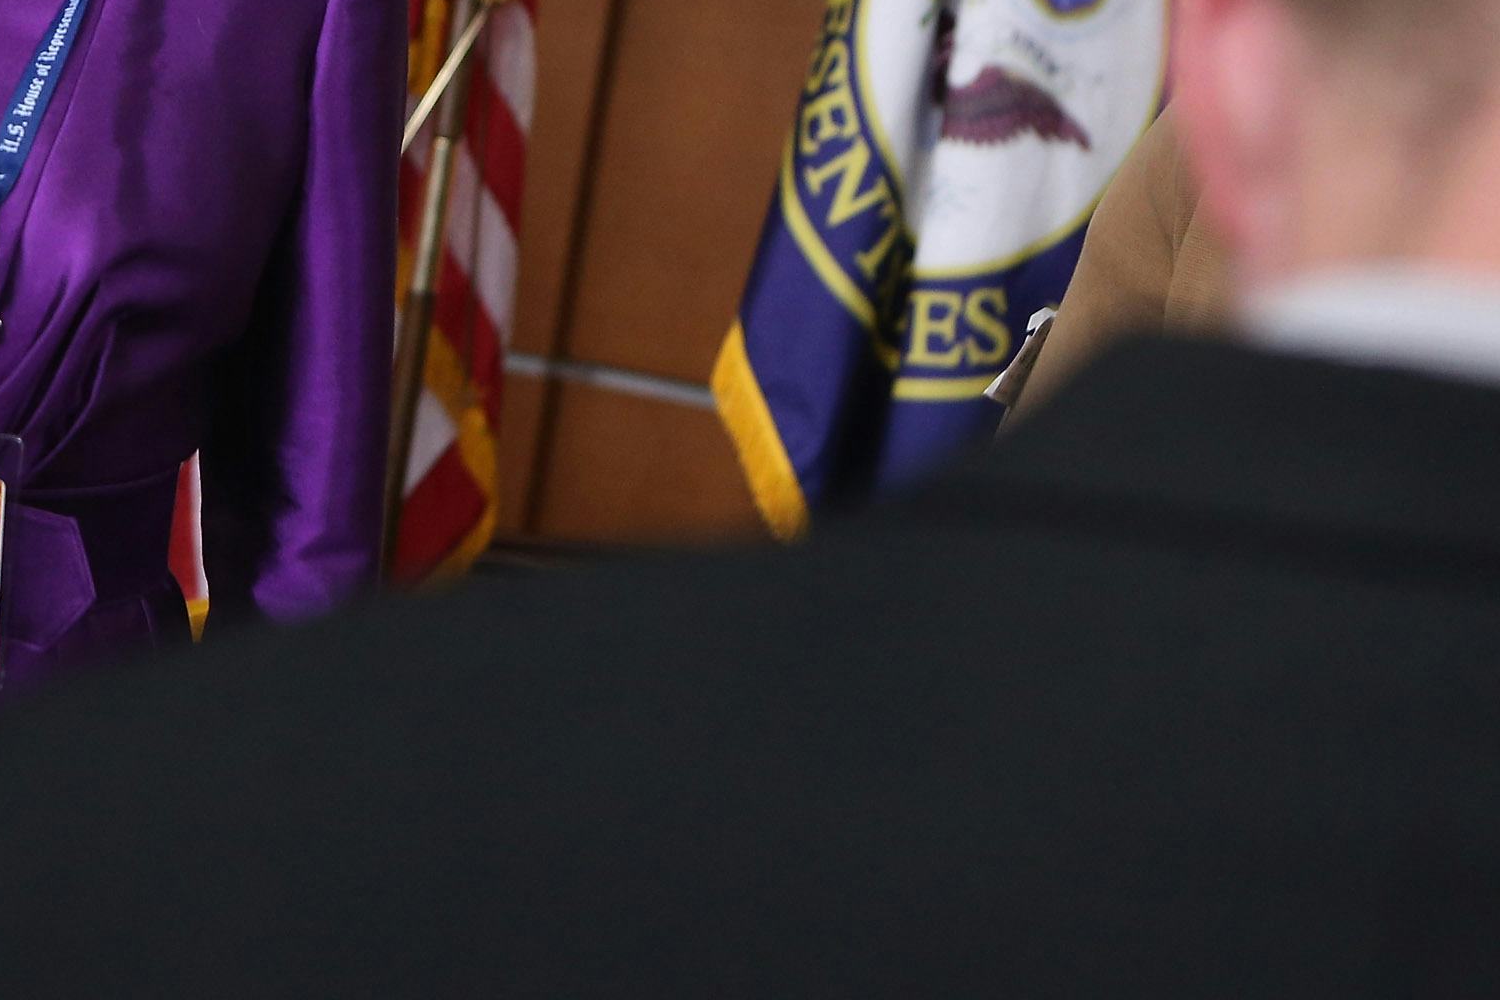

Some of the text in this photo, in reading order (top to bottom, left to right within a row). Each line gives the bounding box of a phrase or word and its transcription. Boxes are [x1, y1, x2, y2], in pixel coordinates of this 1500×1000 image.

[35, 62, 52, 77] of
[12, 76, 45, 117] House
[0, 120, 28, 154] U.S.
